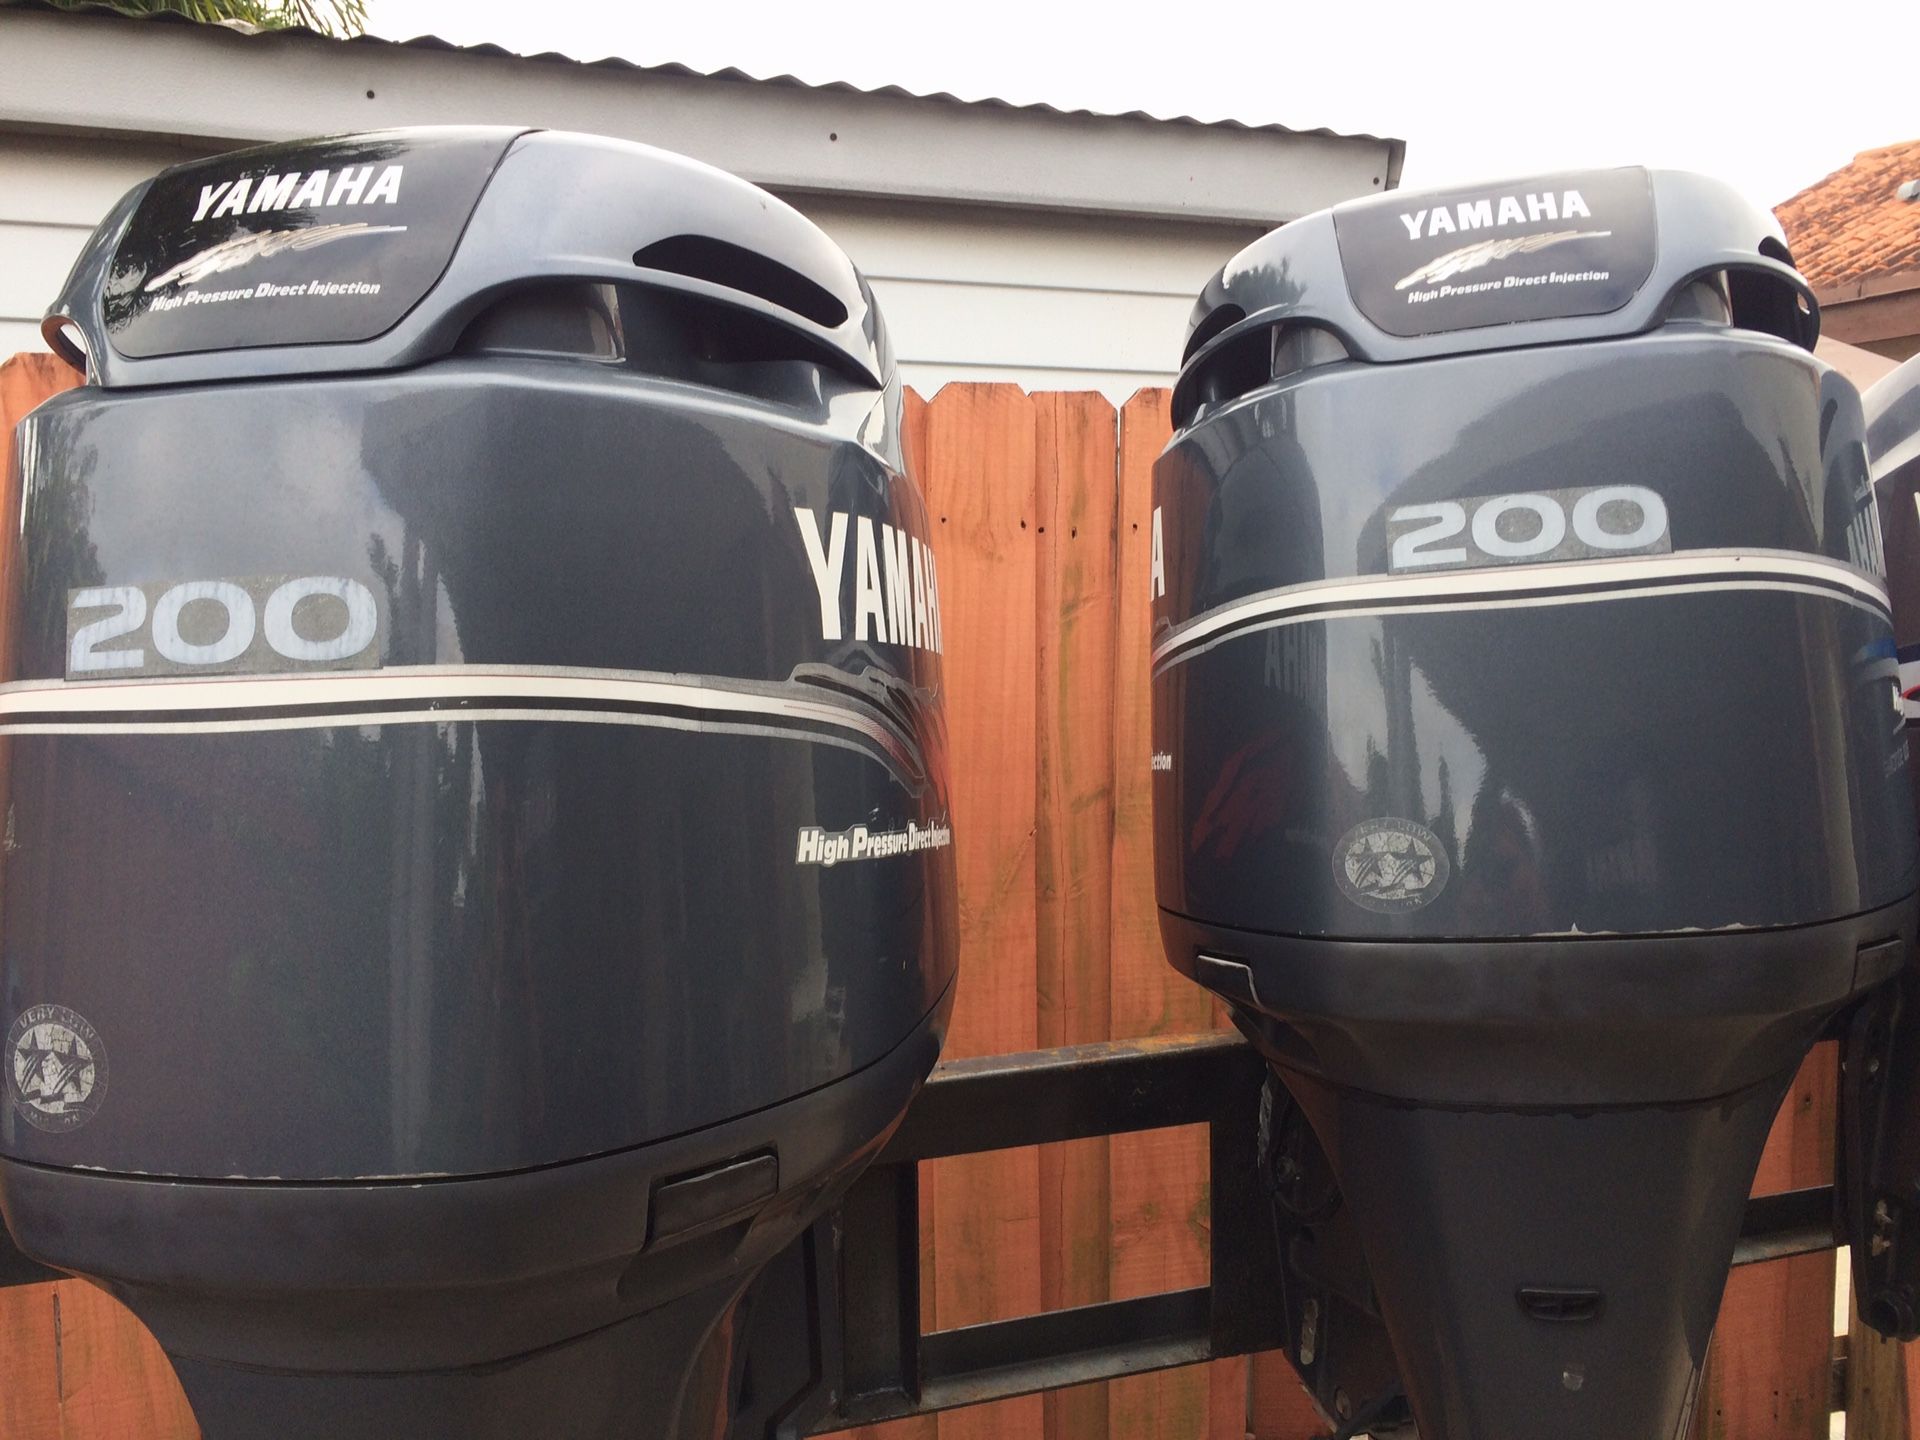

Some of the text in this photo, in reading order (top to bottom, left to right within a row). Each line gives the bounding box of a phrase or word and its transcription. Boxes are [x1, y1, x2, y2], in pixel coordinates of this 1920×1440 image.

[192, 165, 404, 222] YAMAHA
[1400, 190, 1591, 240] YAMAHA
[149, 280, 381, 312] High Pressure Direct Injection
[1408, 271, 1609, 304] High Pressure Direct Injection
[1390, 486, 1668, 569] 200
[794, 507, 943, 656] YAMAH
[71, 576, 378, 673] 200
[798, 830, 850, 865] High
[852, 827, 908, 858] Pressure
[908, 822, 931, 850] Direct
